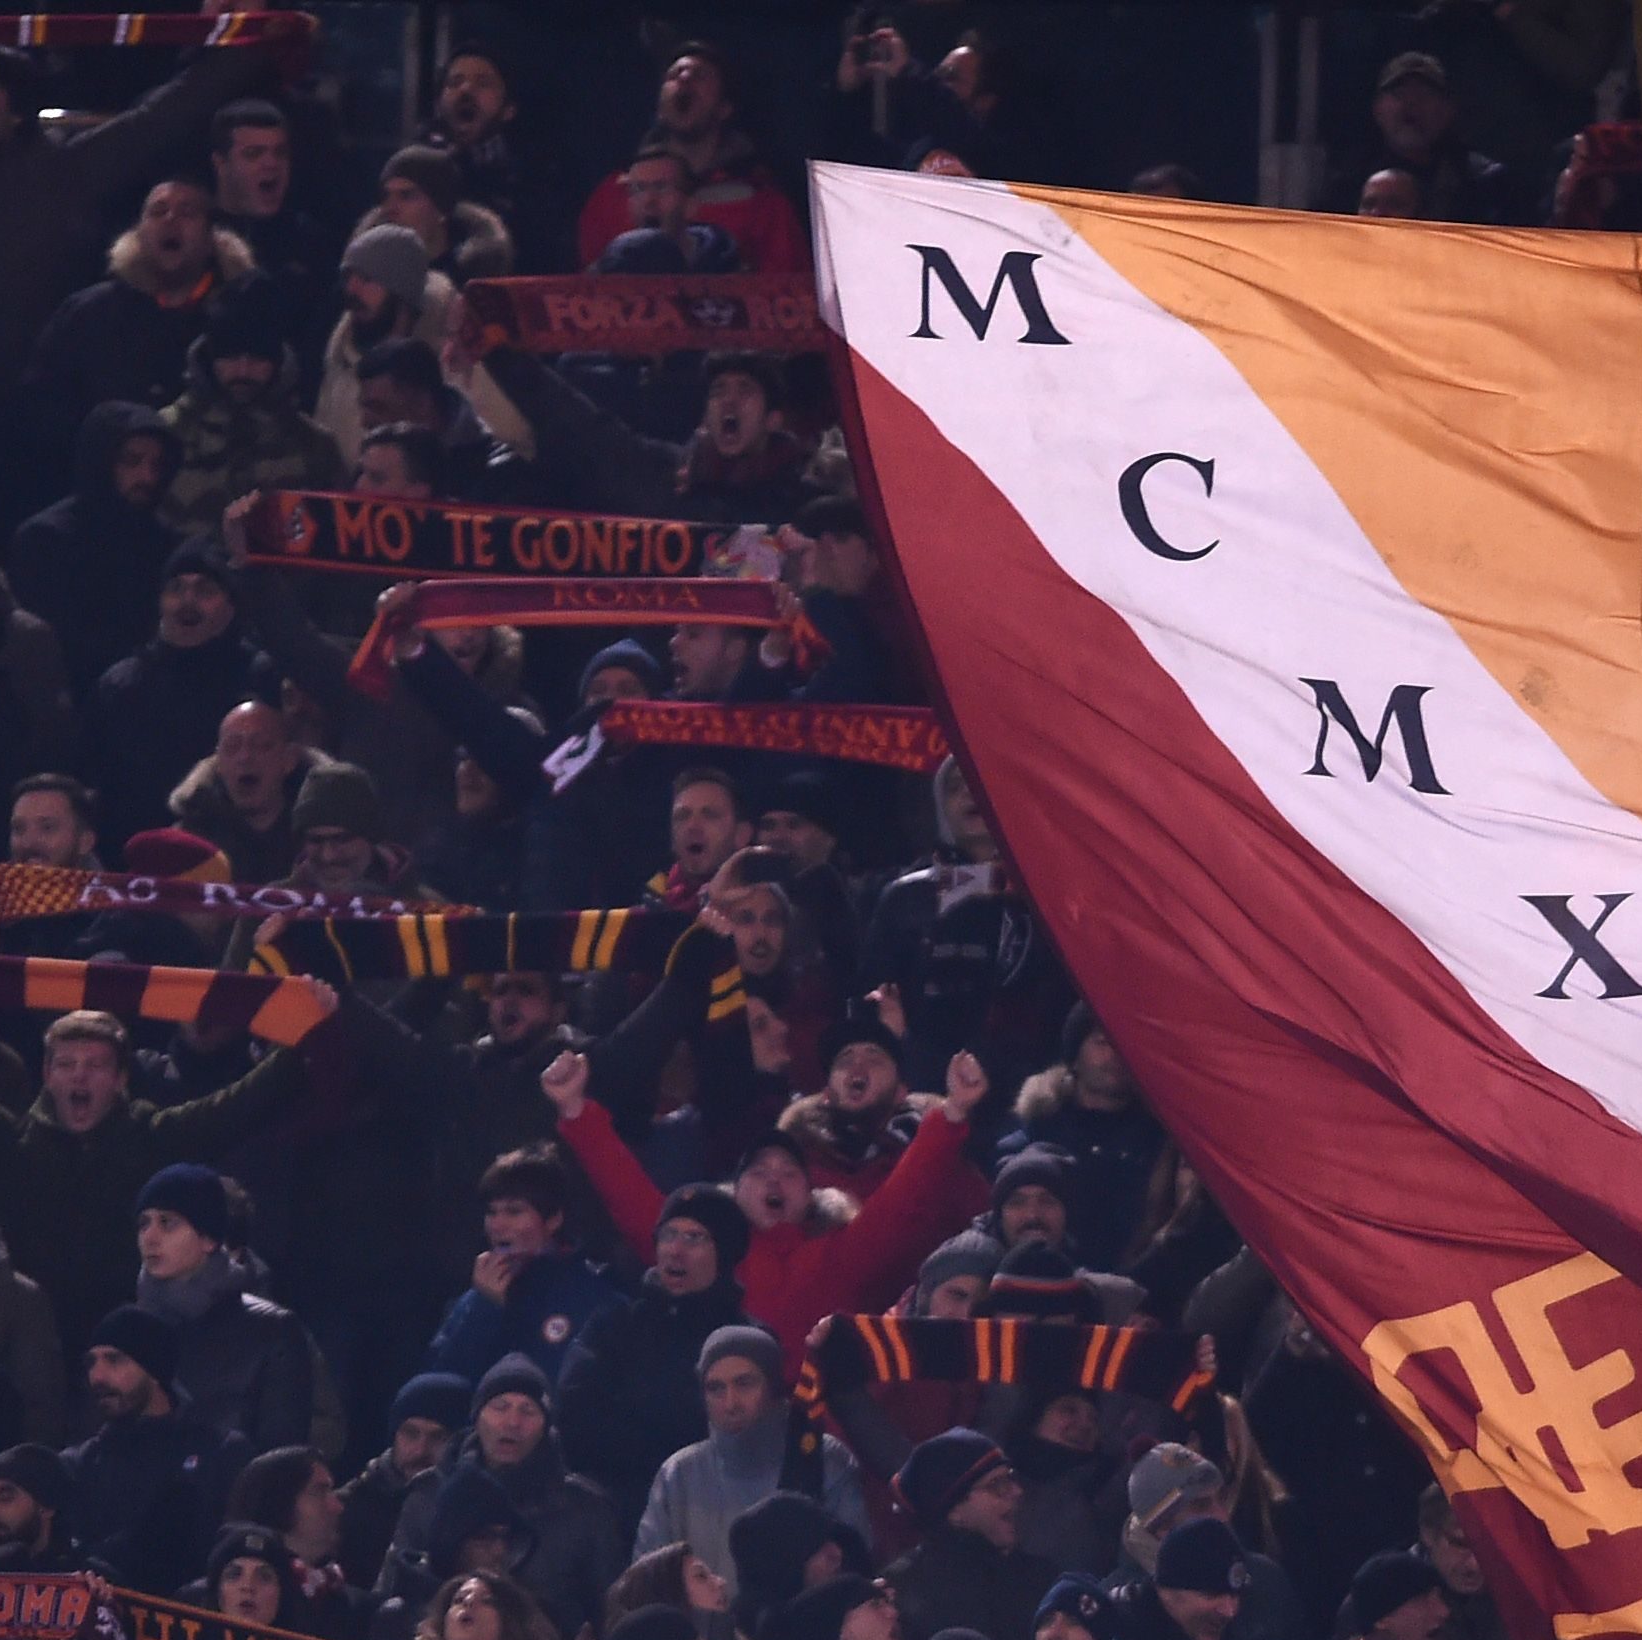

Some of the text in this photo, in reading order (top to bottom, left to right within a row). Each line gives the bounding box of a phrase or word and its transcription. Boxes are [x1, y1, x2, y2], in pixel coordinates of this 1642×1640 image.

[331, 500, 693, 575] MO' TE GONFIO
[554, 583, 703, 610] ROMA
